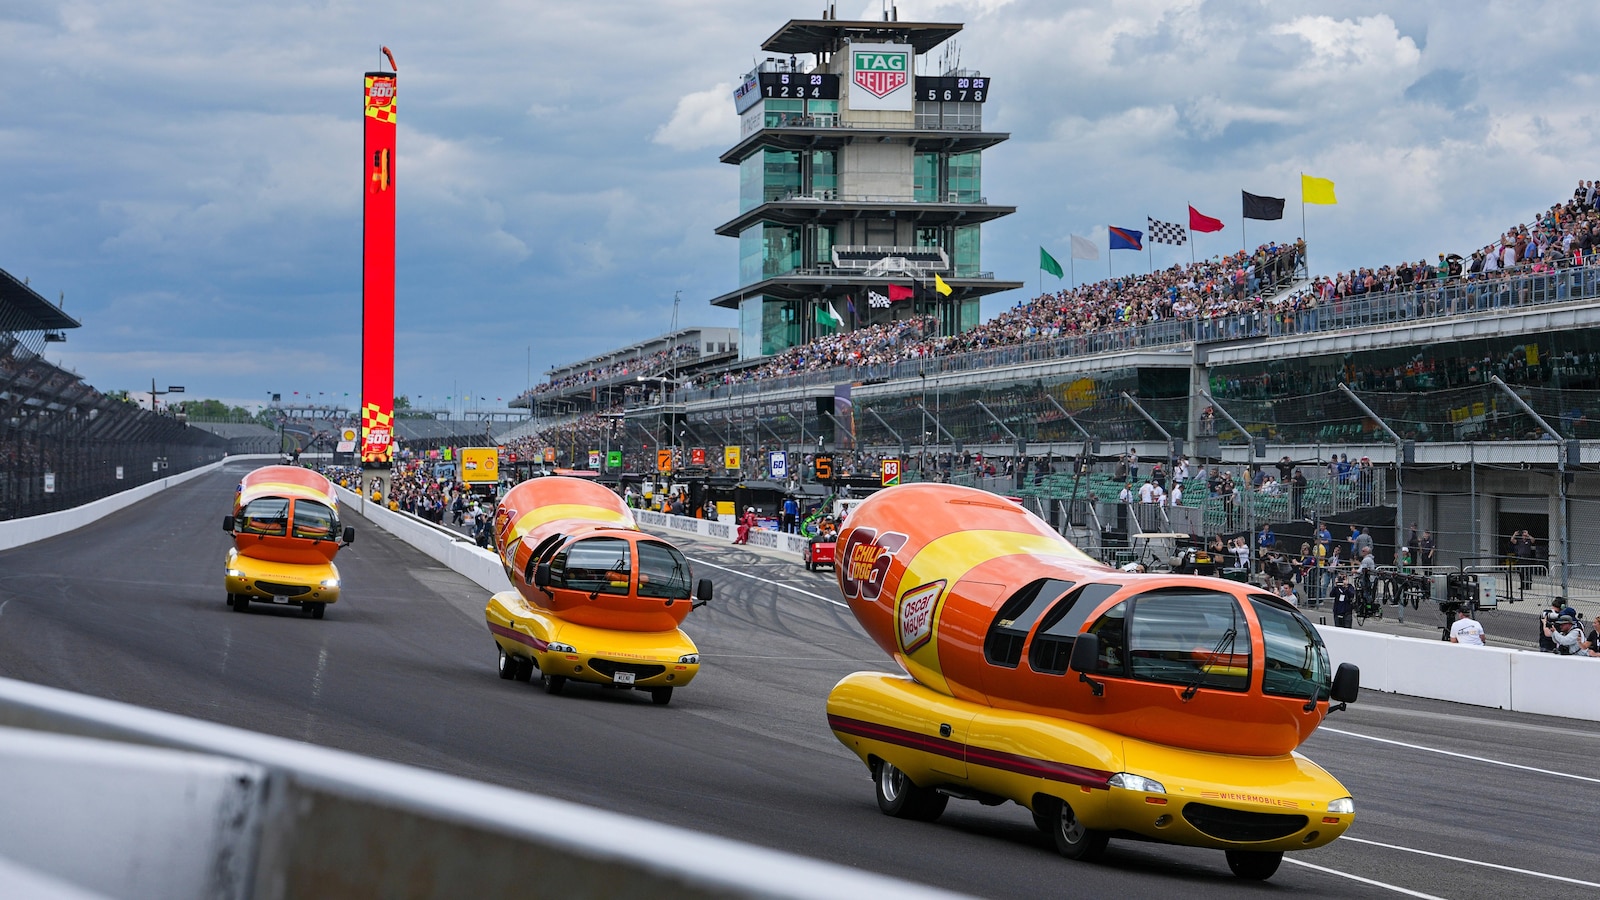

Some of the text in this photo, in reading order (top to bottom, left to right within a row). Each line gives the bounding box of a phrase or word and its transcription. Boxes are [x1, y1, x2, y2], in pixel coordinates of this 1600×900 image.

[858, 55, 903, 69] TAG
[781, 74, 822, 85] 5 23
[857, 72, 904, 94] HEUER
[958, 79, 984, 89] 20 25
[370, 87, 393, 97] 500
[766, 86, 773, 97] 1
[780, 86, 789, 97] 2
[796, 86, 805, 97] 3
[811, 87, 820, 98] 4
[928, 90, 982, 101] 5 6 7 8
[367, 434, 390, 444] 500
[773, 460, 784, 469] 60
[815, 458, 832, 479] 5
[885, 462, 897, 475] 83
[854, 545, 882, 563] CHILI
[854, 562, 873, 580] DOG
[903, 610, 929, 637] Mayer
[1220, 793, 1282, 806] WIENERMOBILE
